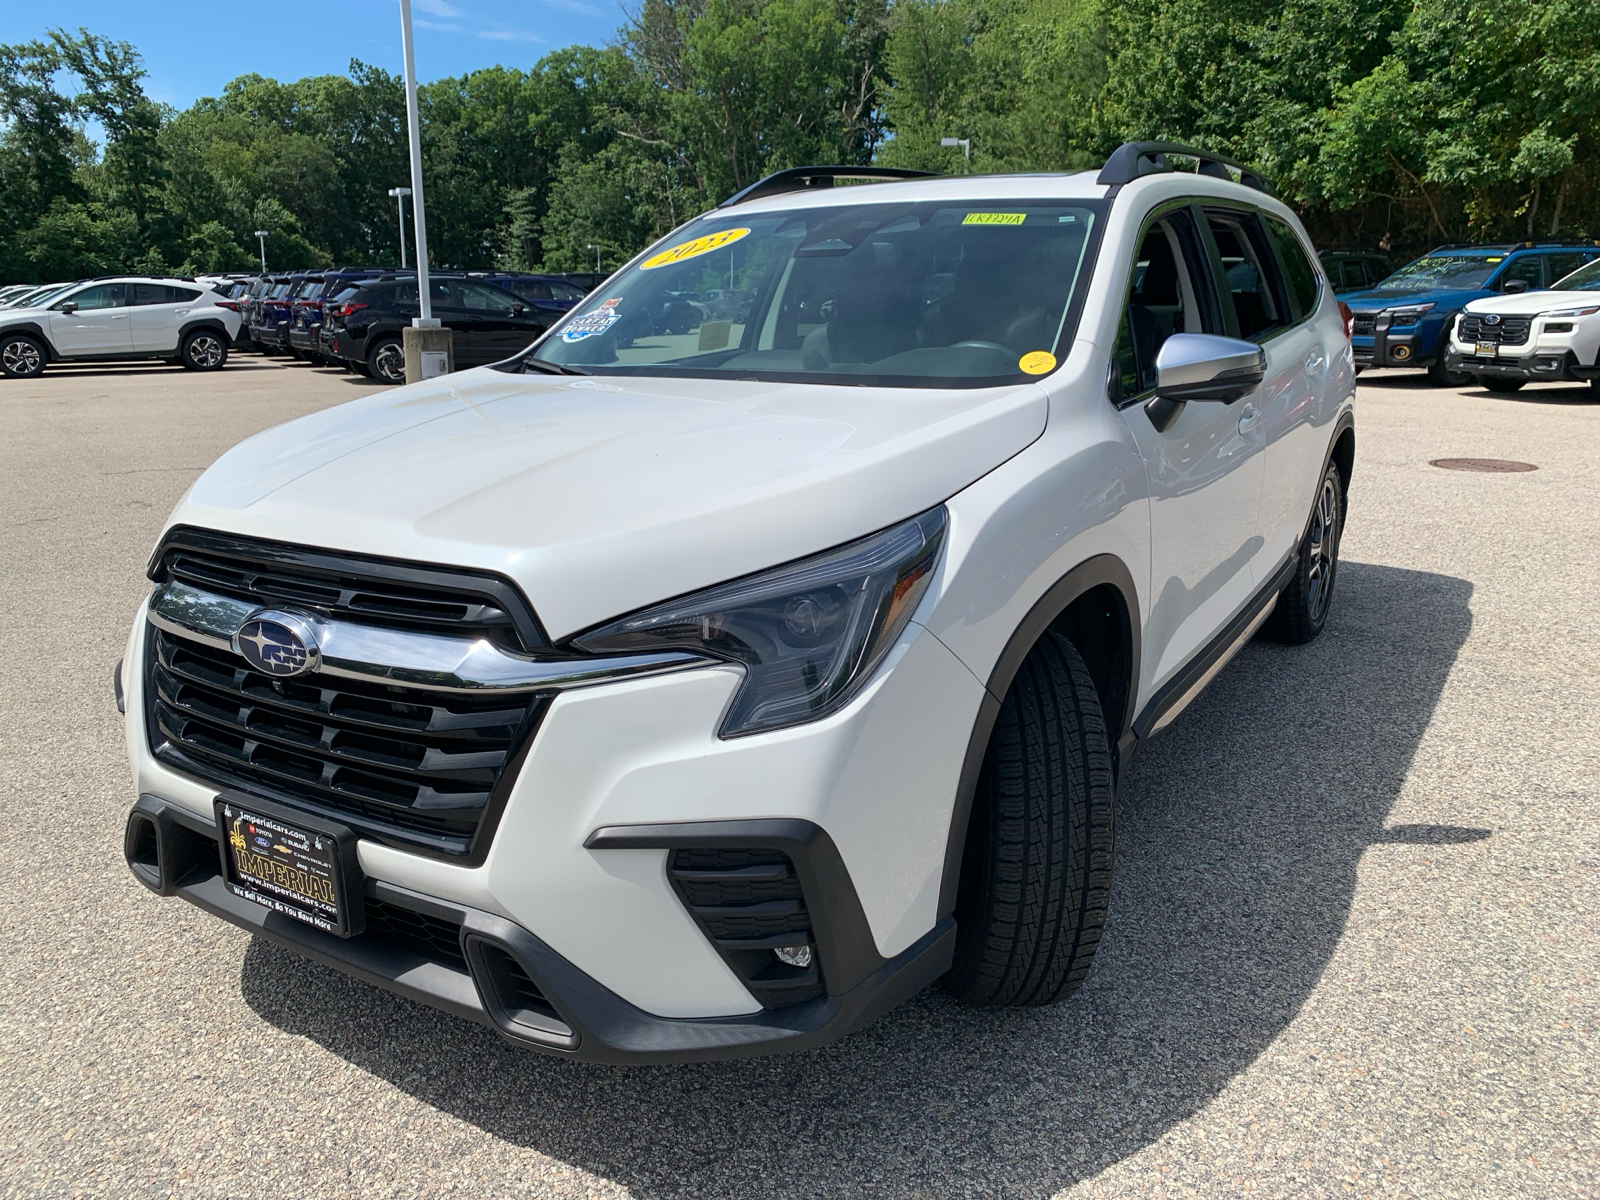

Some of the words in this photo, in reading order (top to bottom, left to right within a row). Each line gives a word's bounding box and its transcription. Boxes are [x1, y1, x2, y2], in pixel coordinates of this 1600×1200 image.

[655, 231, 733, 265] 2023
[255, 827, 273, 839] TOYOTA
[236, 847, 336, 906] IMPERIAL
[233, 885, 244, 897] We
[244, 890, 256, 901] Sell
[274, 902, 283, 912] So
[283, 904, 297, 917] You
[297, 911, 313, 924] Save
[314, 917, 331, 931] More
